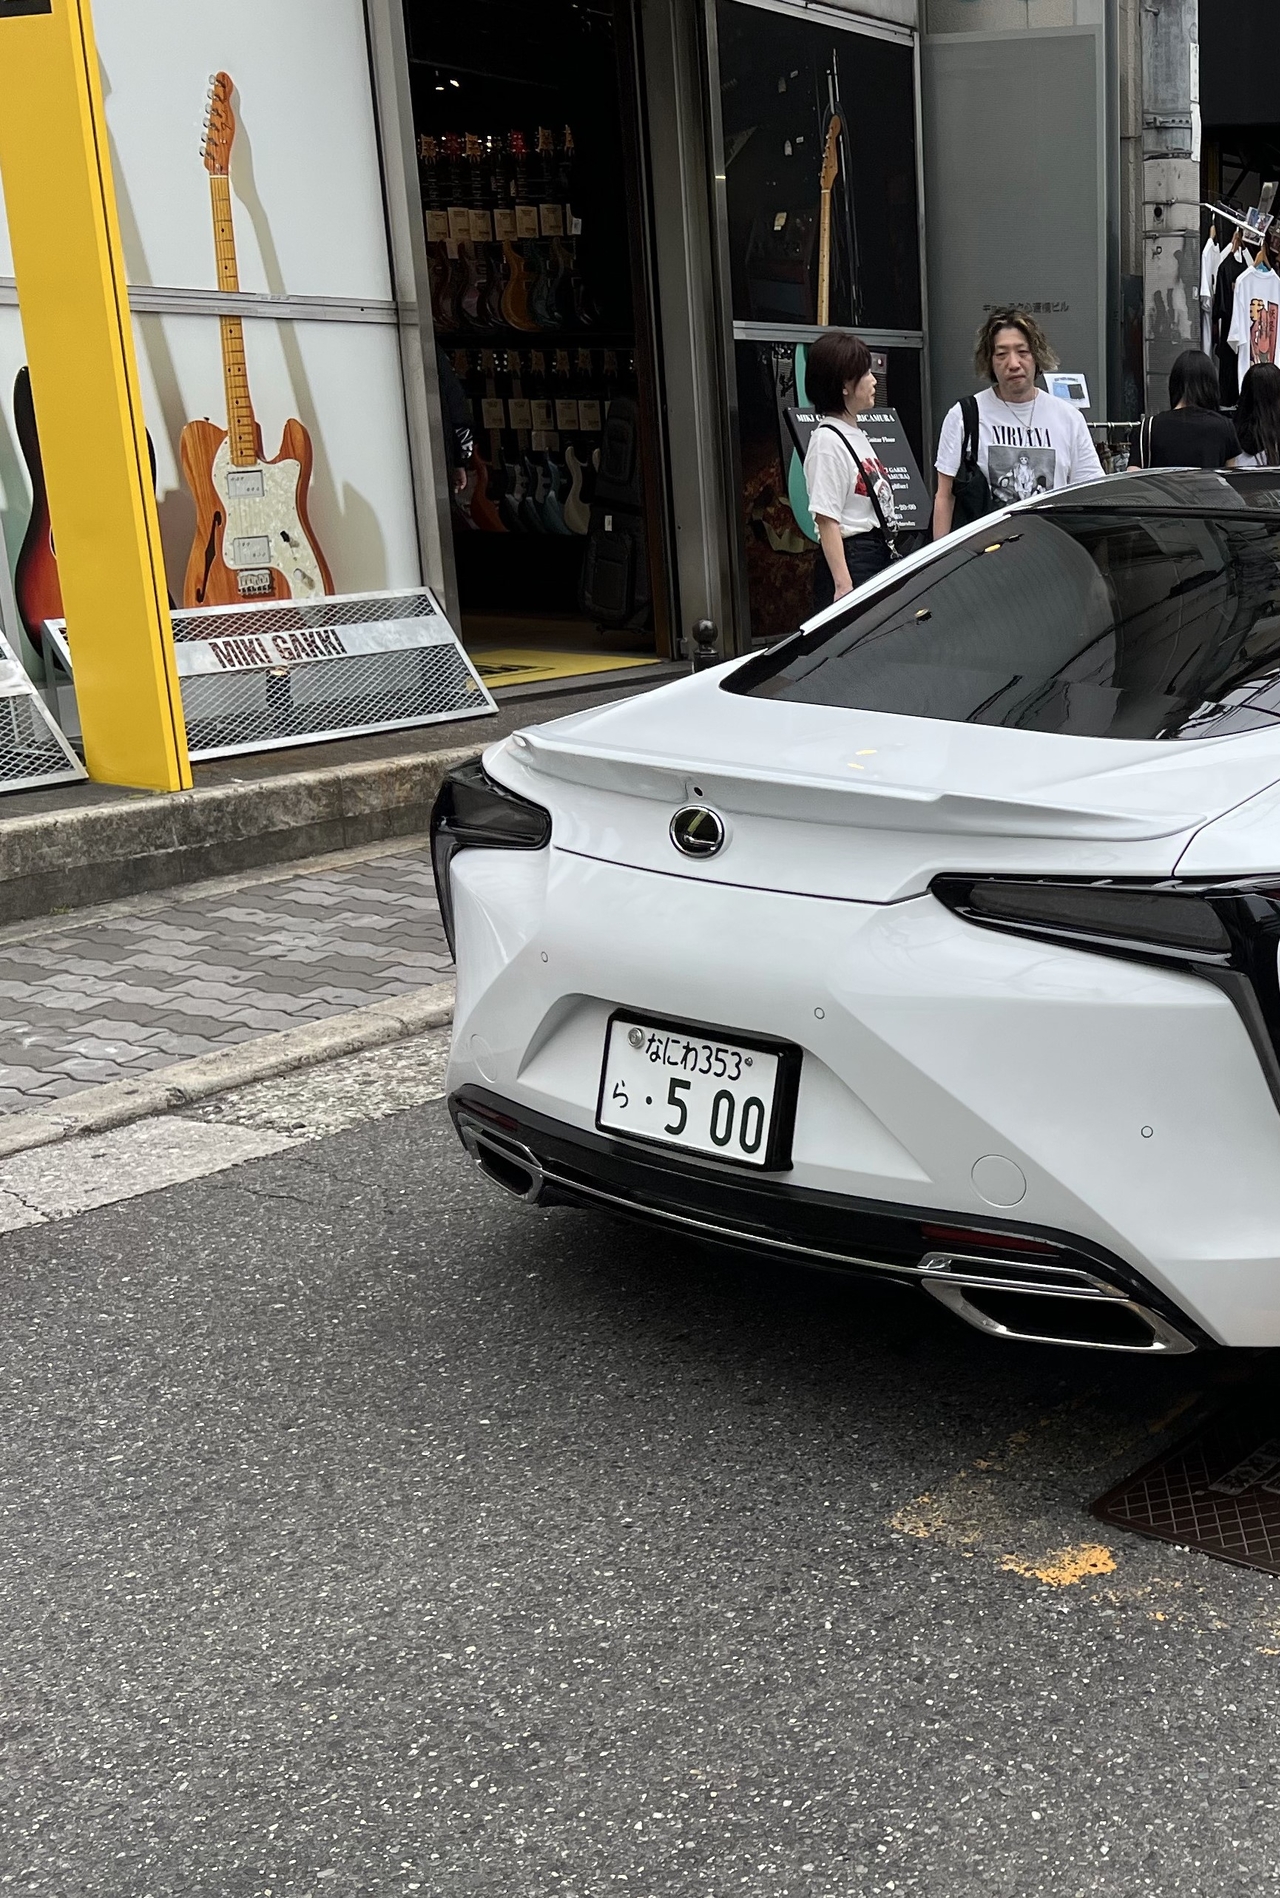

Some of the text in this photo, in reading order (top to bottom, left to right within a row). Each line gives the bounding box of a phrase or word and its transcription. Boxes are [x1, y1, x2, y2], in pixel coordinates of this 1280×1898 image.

[992, 425, 1052, 448] NIRVANA
[208, 628, 348, 669] MIKI GAKKI
[612, 1079, 629, 1110] ら
